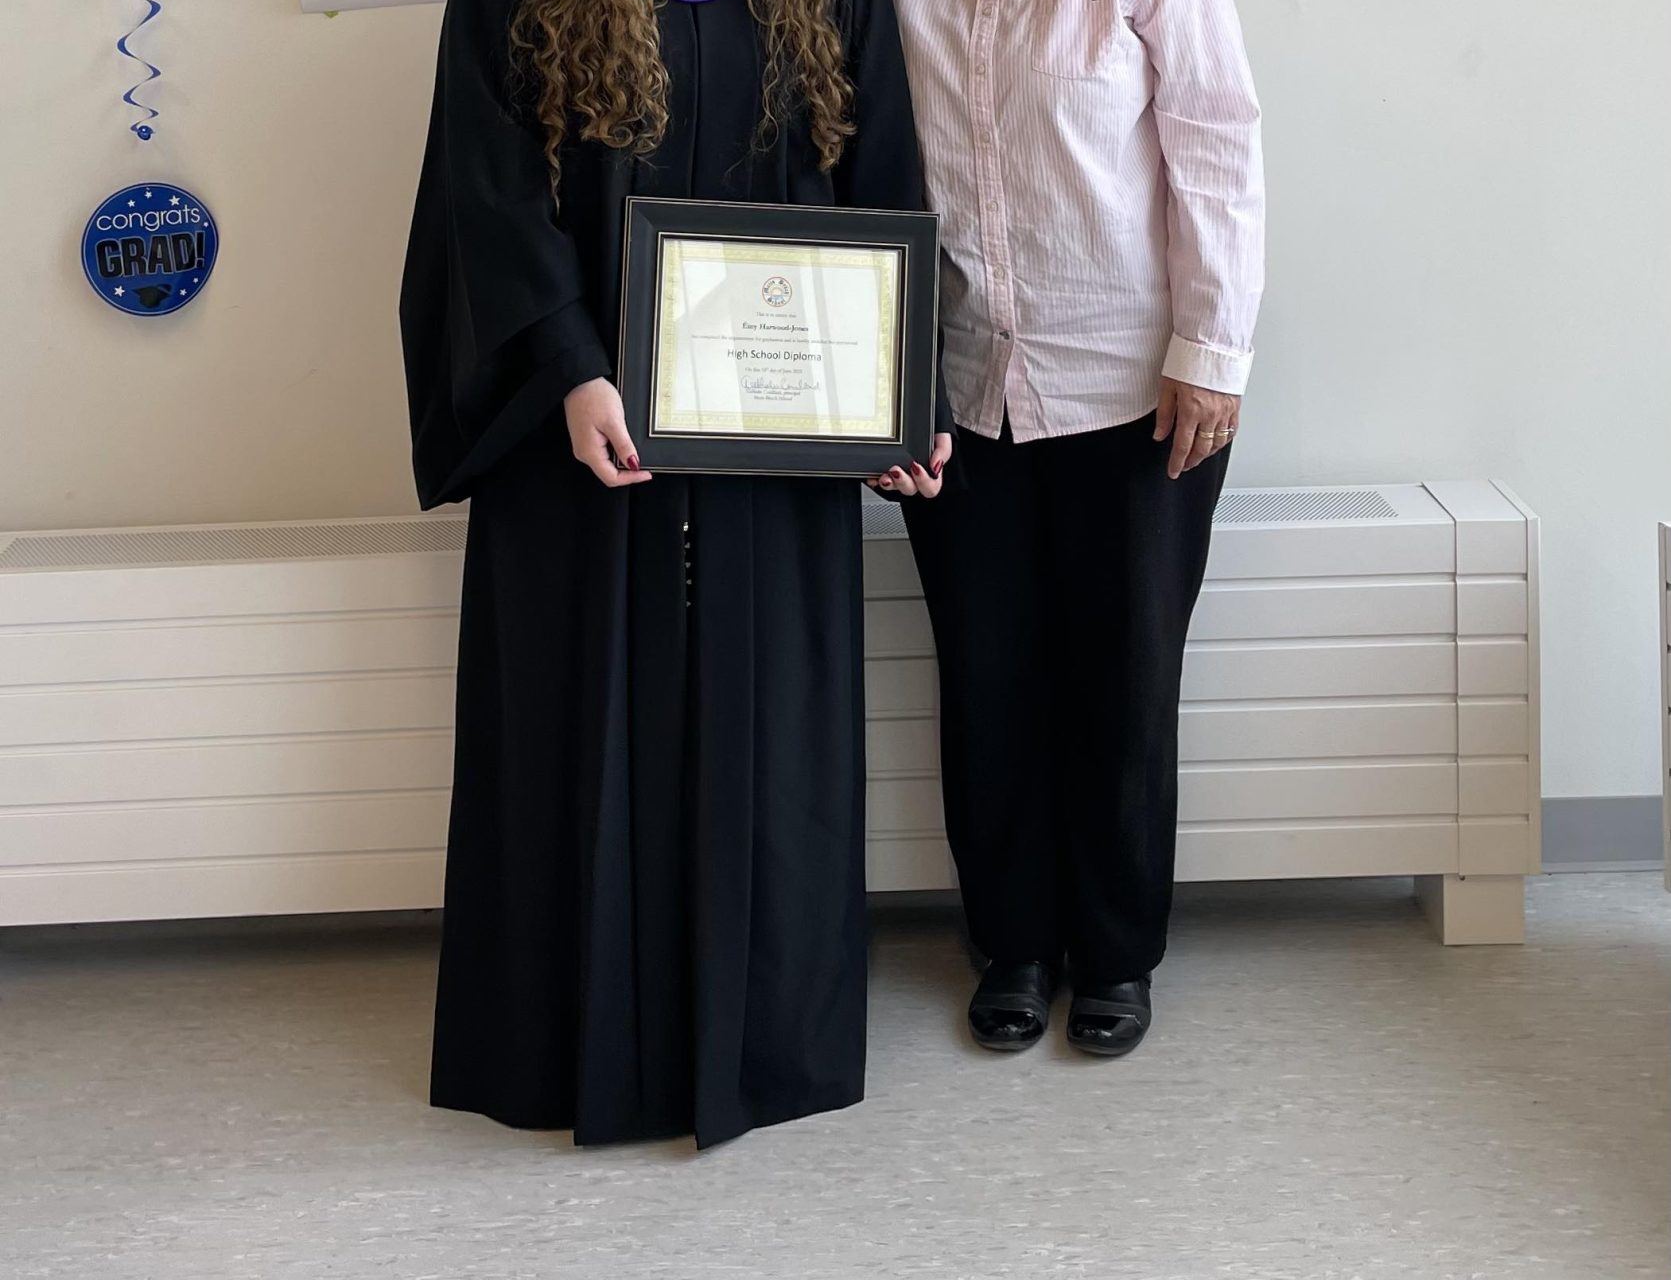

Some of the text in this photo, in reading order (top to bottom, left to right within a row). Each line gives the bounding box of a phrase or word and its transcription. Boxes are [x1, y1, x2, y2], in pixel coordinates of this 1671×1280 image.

[96, 204, 201, 232] congrats
[95, 230, 206, 279] GRAD!
[727, 348, 822, 363] High School Diploma
